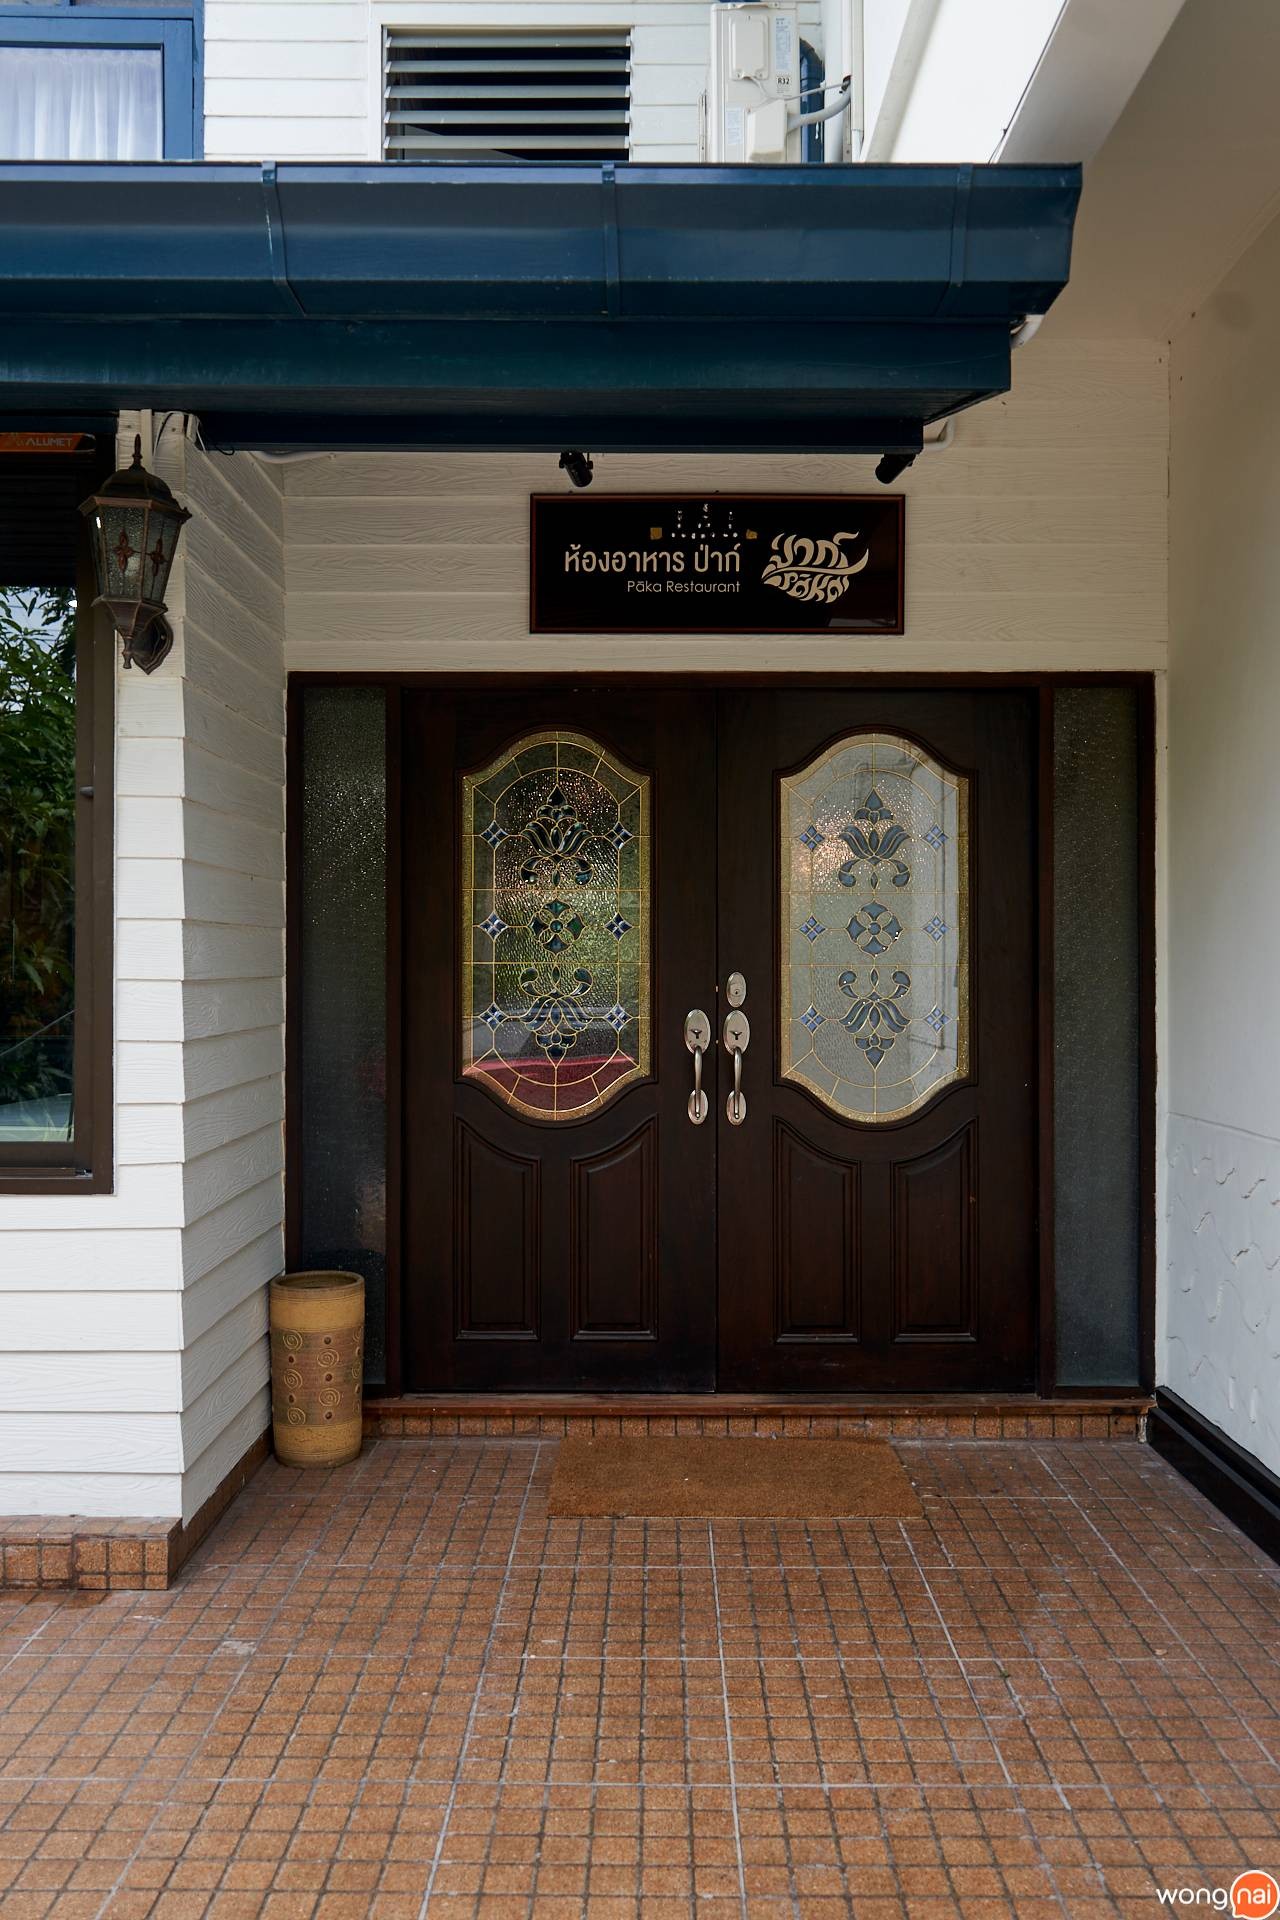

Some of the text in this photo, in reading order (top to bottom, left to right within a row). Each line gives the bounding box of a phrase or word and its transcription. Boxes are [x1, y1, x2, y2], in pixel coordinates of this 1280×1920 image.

[777, 77, 791, 86] R32
[564, 542, 741, 573] ห้องอาหาร ป่าก์
[666, 579, 741, 593] Restaurant
